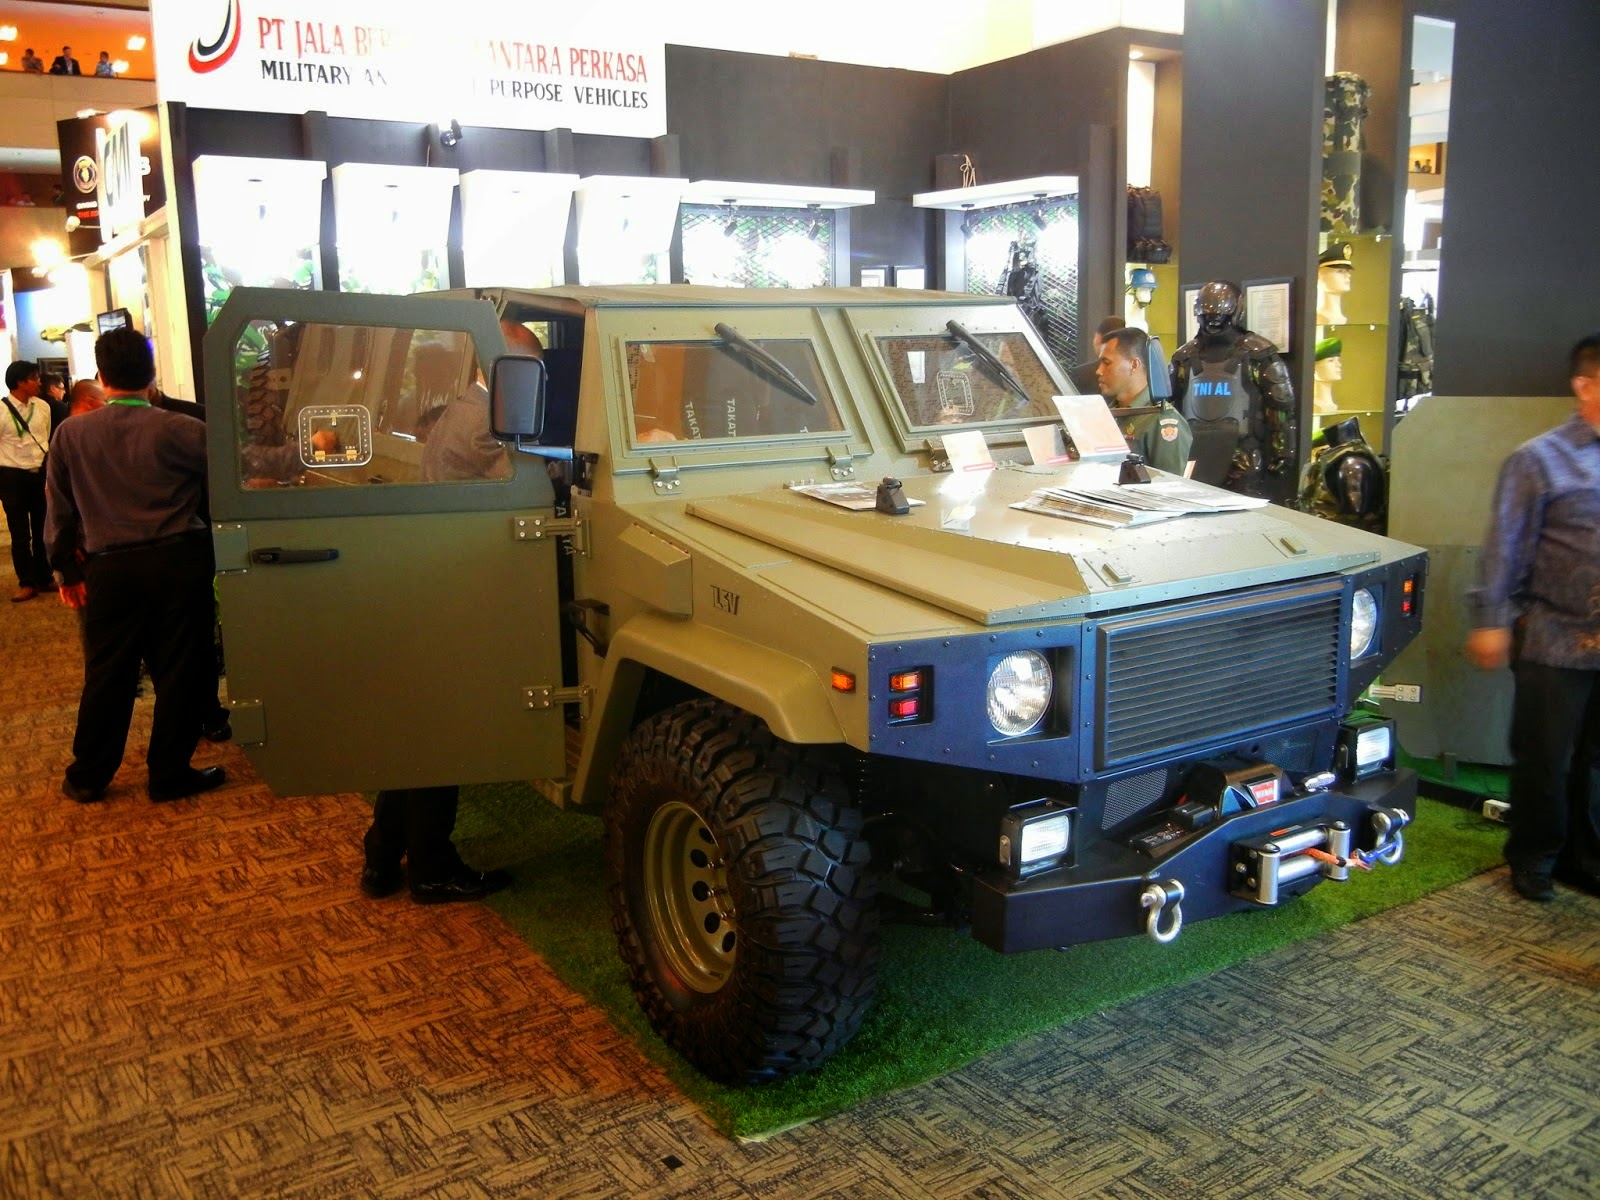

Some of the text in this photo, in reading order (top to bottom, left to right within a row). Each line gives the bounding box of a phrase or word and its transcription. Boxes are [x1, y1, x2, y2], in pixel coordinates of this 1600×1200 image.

[257, 16, 286, 51] PT
[294, 20, 346, 59] JALA
[568, 47, 649, 84] PERKASA
[260, 59, 351, 86] MILITARY
[574, 85, 649, 110] VEHICLES
[1193, 382, 1231, 397] TNI AL
